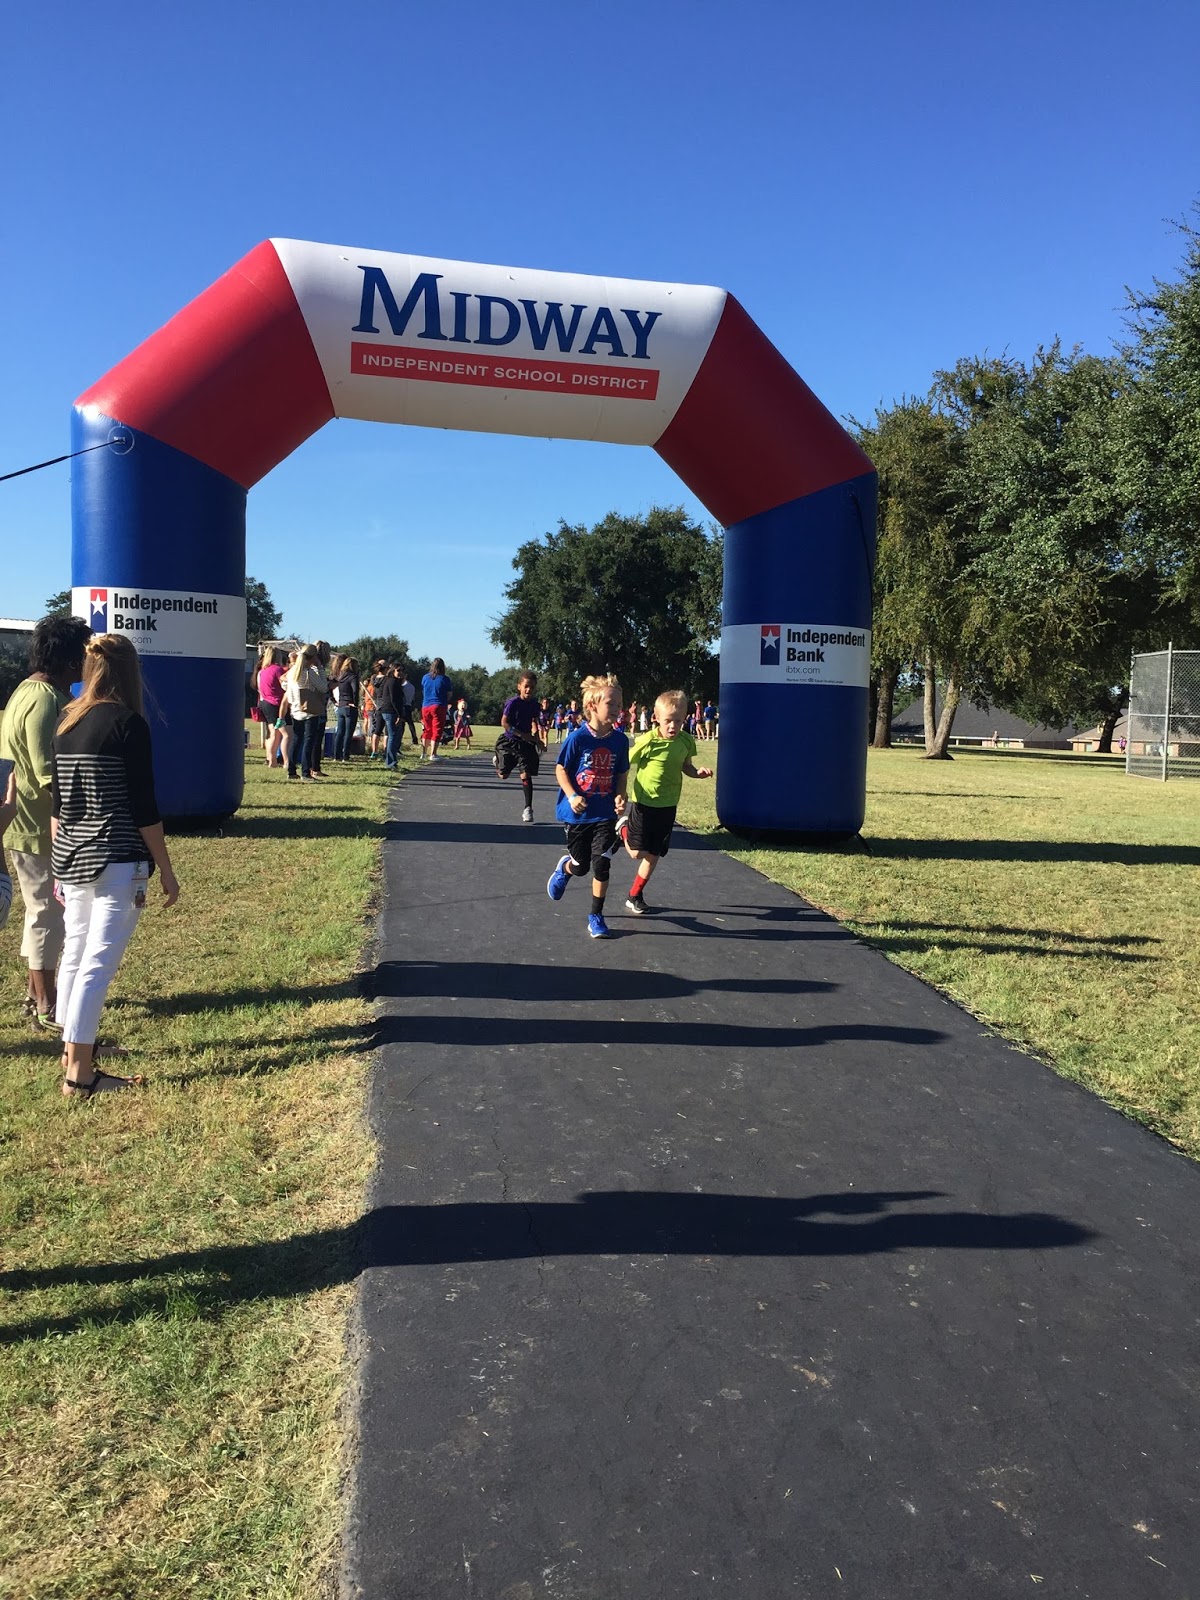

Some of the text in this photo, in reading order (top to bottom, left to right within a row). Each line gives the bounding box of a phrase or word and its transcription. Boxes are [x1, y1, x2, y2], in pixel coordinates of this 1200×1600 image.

[351, 265, 662, 359] MIDWAY
[362, 354, 649, 390] INDEPENDENT SCHOOL DISTRICT
[114, 593, 218, 614] Independent
[114, 614, 158, 631] Bank
[131, 636, 152, 644] com
[787, 628, 866, 647] Independent
[786, 647, 825, 663] Bank
[785, 665, 821, 674] ibtx.com
